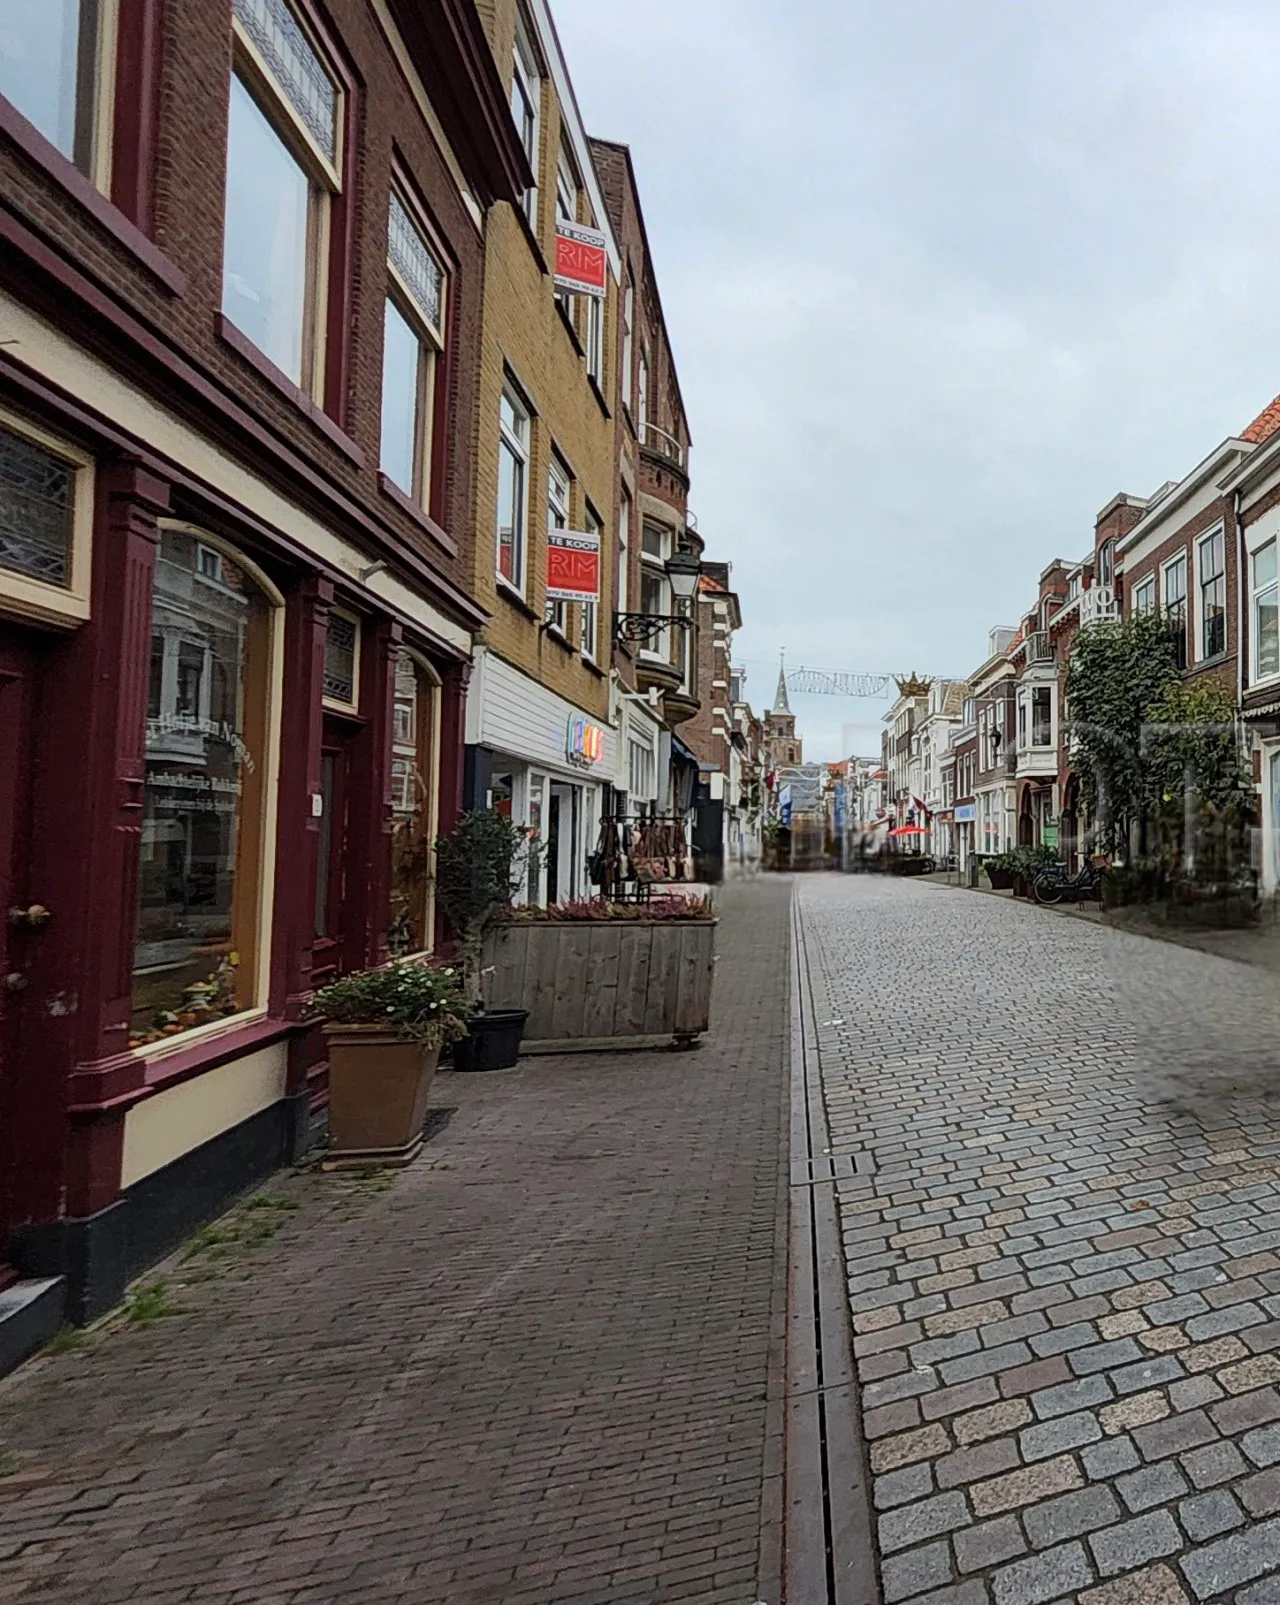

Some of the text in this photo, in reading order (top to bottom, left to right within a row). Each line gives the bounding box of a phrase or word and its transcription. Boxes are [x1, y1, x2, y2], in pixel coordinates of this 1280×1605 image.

[558, 226, 605, 247] TE KOOP
[559, 241, 603, 275] RIM
[550, 536, 599, 551] TE KOOP
[551, 551, 597, 579] RIM
